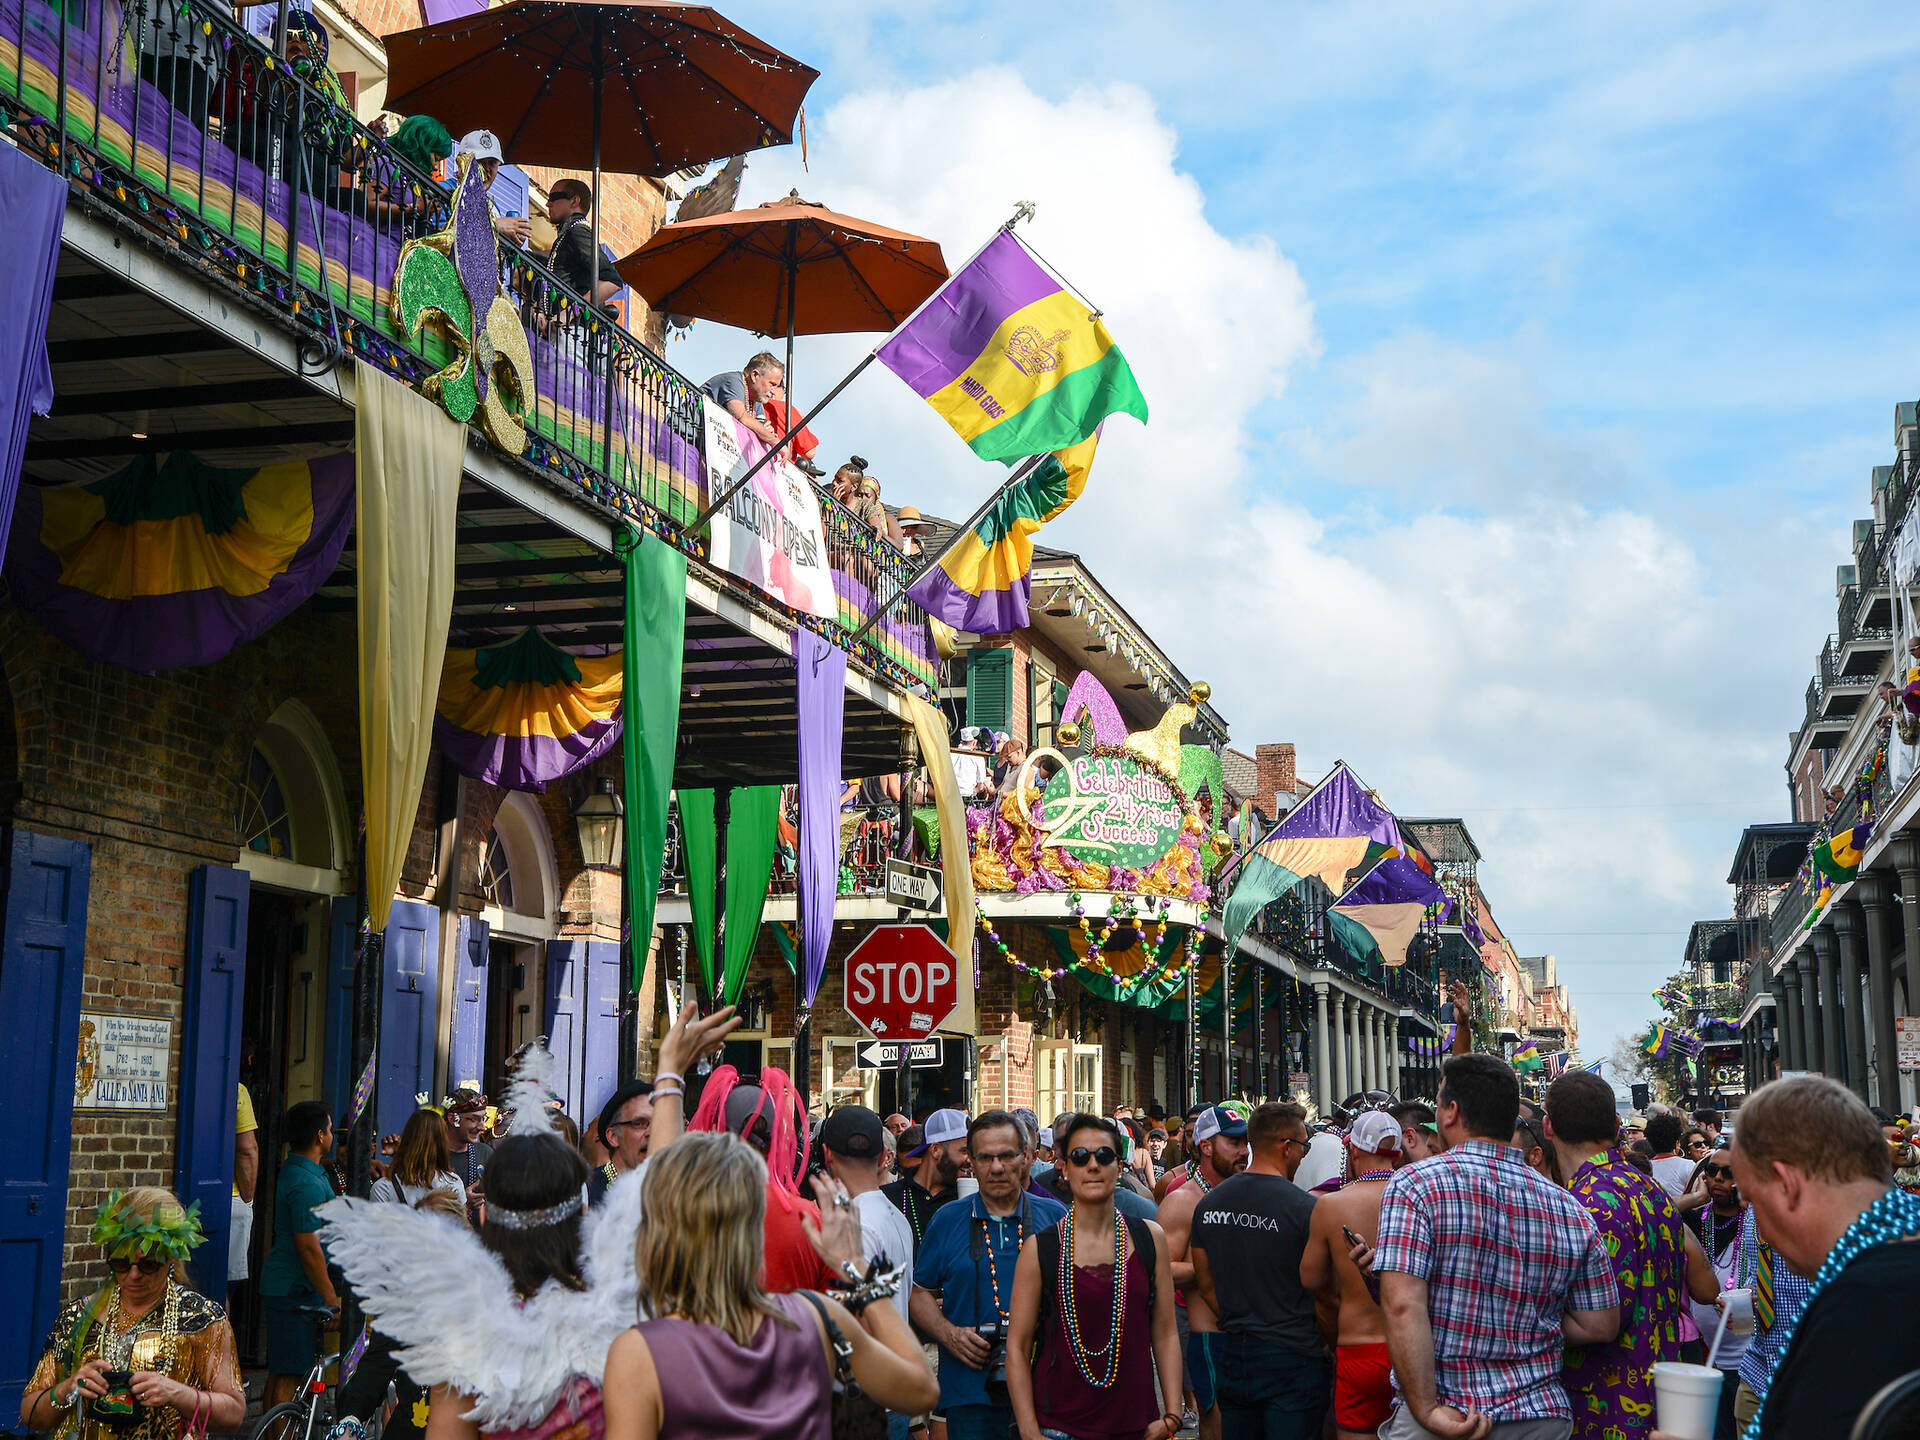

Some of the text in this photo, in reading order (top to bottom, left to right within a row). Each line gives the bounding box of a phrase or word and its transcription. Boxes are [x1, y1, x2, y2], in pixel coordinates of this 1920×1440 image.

[958, 376, 1006, 419] MARDI GRAS
[711, 466, 820, 570] BALCONY OPEN
[1075, 758, 1171, 803] Celebrating
[1081, 811, 1158, 845] Success
[1104, 795, 1132, 821] 24
[1163, 805, 1182, 830] of
[892, 874, 926, 897] ONE WAY
[853, 962, 951, 1004] STOP
[119, 1031, 134, 1044] Spanish
[882, 1046, 932, 1059] ON WAY
[96, 1079, 121, 1102] CALLE
[128, 1079, 148, 1102] SANTA
[150, 1082, 165, 1103] ANA
[1202, 1210, 1279, 1233] SKYY VODKA
